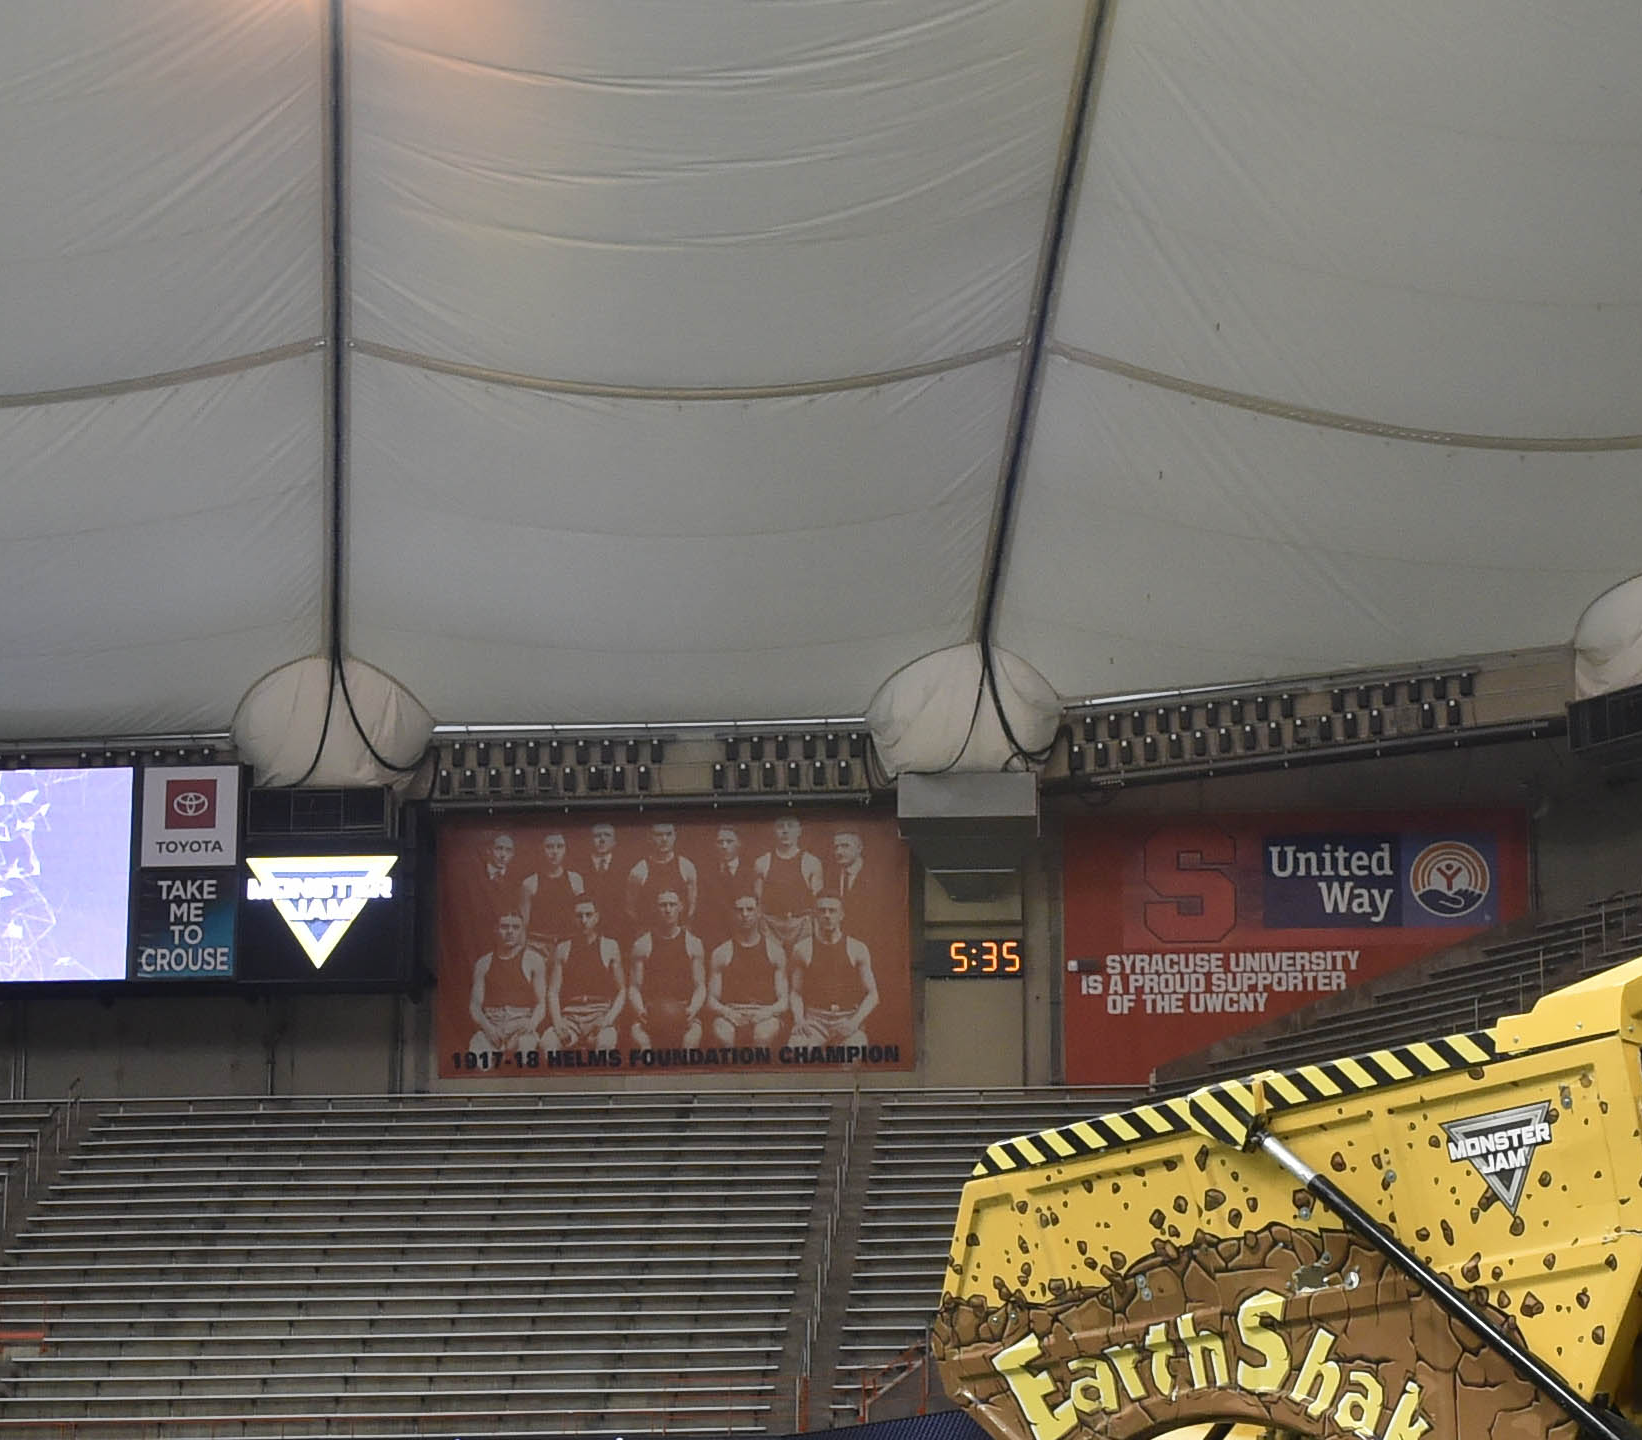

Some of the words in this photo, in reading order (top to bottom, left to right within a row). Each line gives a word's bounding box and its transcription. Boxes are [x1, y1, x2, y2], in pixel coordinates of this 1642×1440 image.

[155, 841, 223, 853] TOYOTA
[1269, 843, 1394, 877] United
[157, 880, 218, 900] TAKE
[1318, 881, 1394, 923] Way
[170, 903, 204, 922] ME
[170, 925, 203, 944] TO
[141, 948, 229, 972] CROUSE
[950, 942, 1020, 972] 5:35
[1106, 953, 1224, 974] SYRACUSE
[1229, 951, 1360, 972] UNIVERSITY
[1081, 975, 1103, 995] IS
[1108, 974, 1124, 994] A
[1129, 973, 1206, 994] PROUD
[1211, 971, 1347, 992] SUPPORTER
[1107, 995, 1136, 1015] OF
[1142, 995, 1185, 1014] THE
[1190, 993, 1269, 1013] UWCNY
[452, 1051, 539, 1070] 1917-18
[547, 1049, 622, 1068] HELMS
[629, 1047, 771, 1068] FOUNDATION
[779, 1044, 900, 1064] CHAMPION
[1448, 1122, 1551, 1161] MONSTER
[1481, 1148, 1527, 1174] JAM
